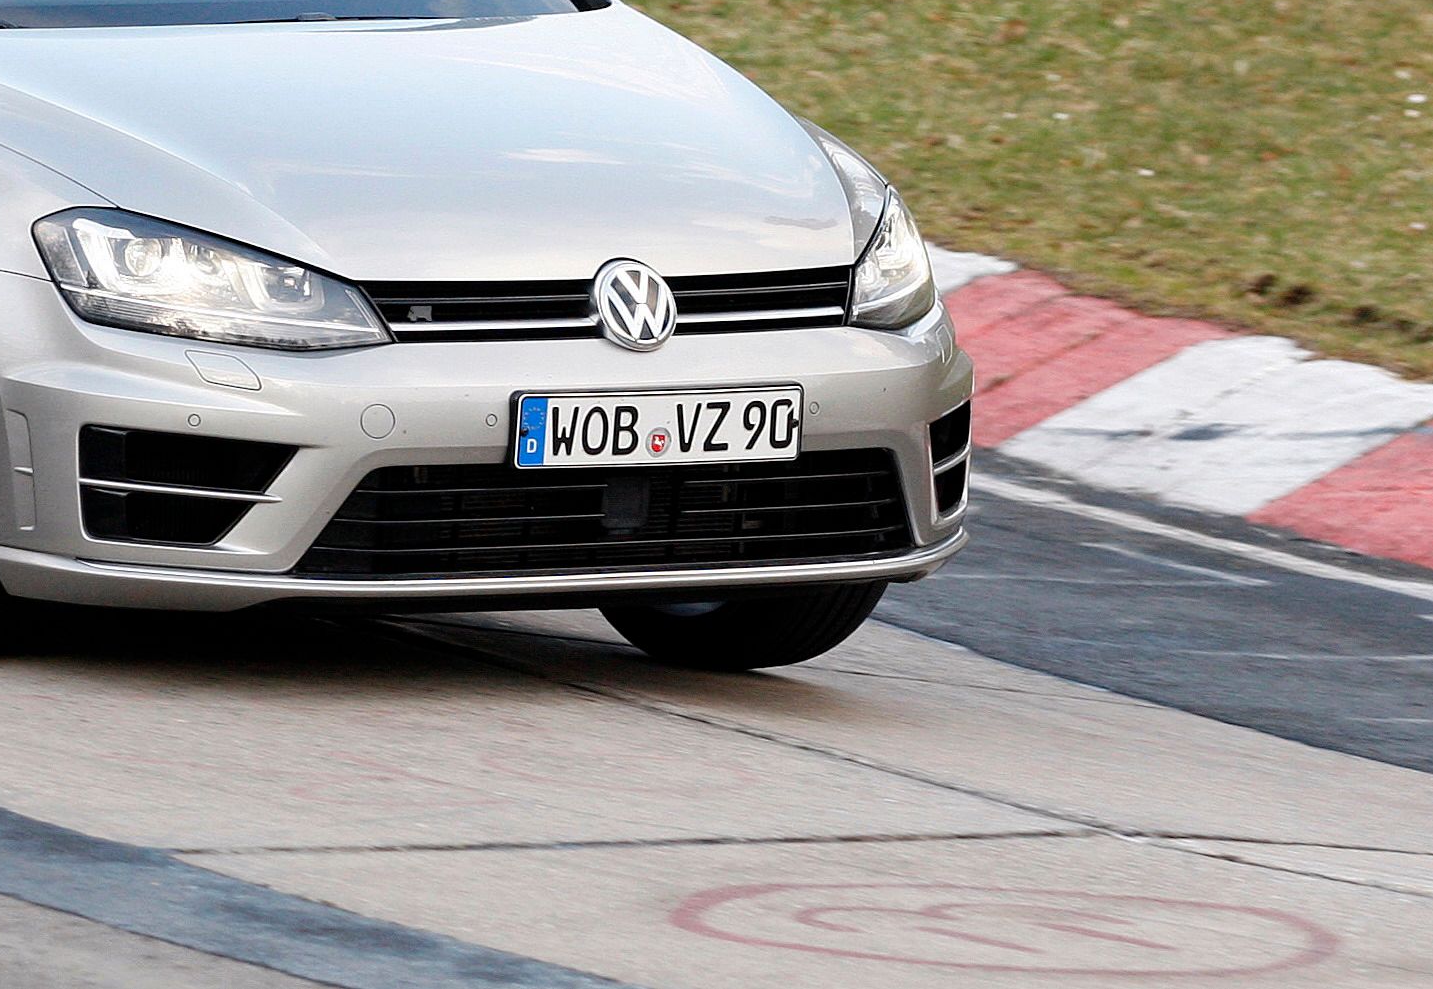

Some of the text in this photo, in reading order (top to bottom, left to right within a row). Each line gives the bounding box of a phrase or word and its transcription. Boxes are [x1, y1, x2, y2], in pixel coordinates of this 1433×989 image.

[604, 262, 673, 345] VW
[526, 438, 537, 454] D
[551, 405, 640, 456] WOB
[676, 400, 732, 452] VZ
